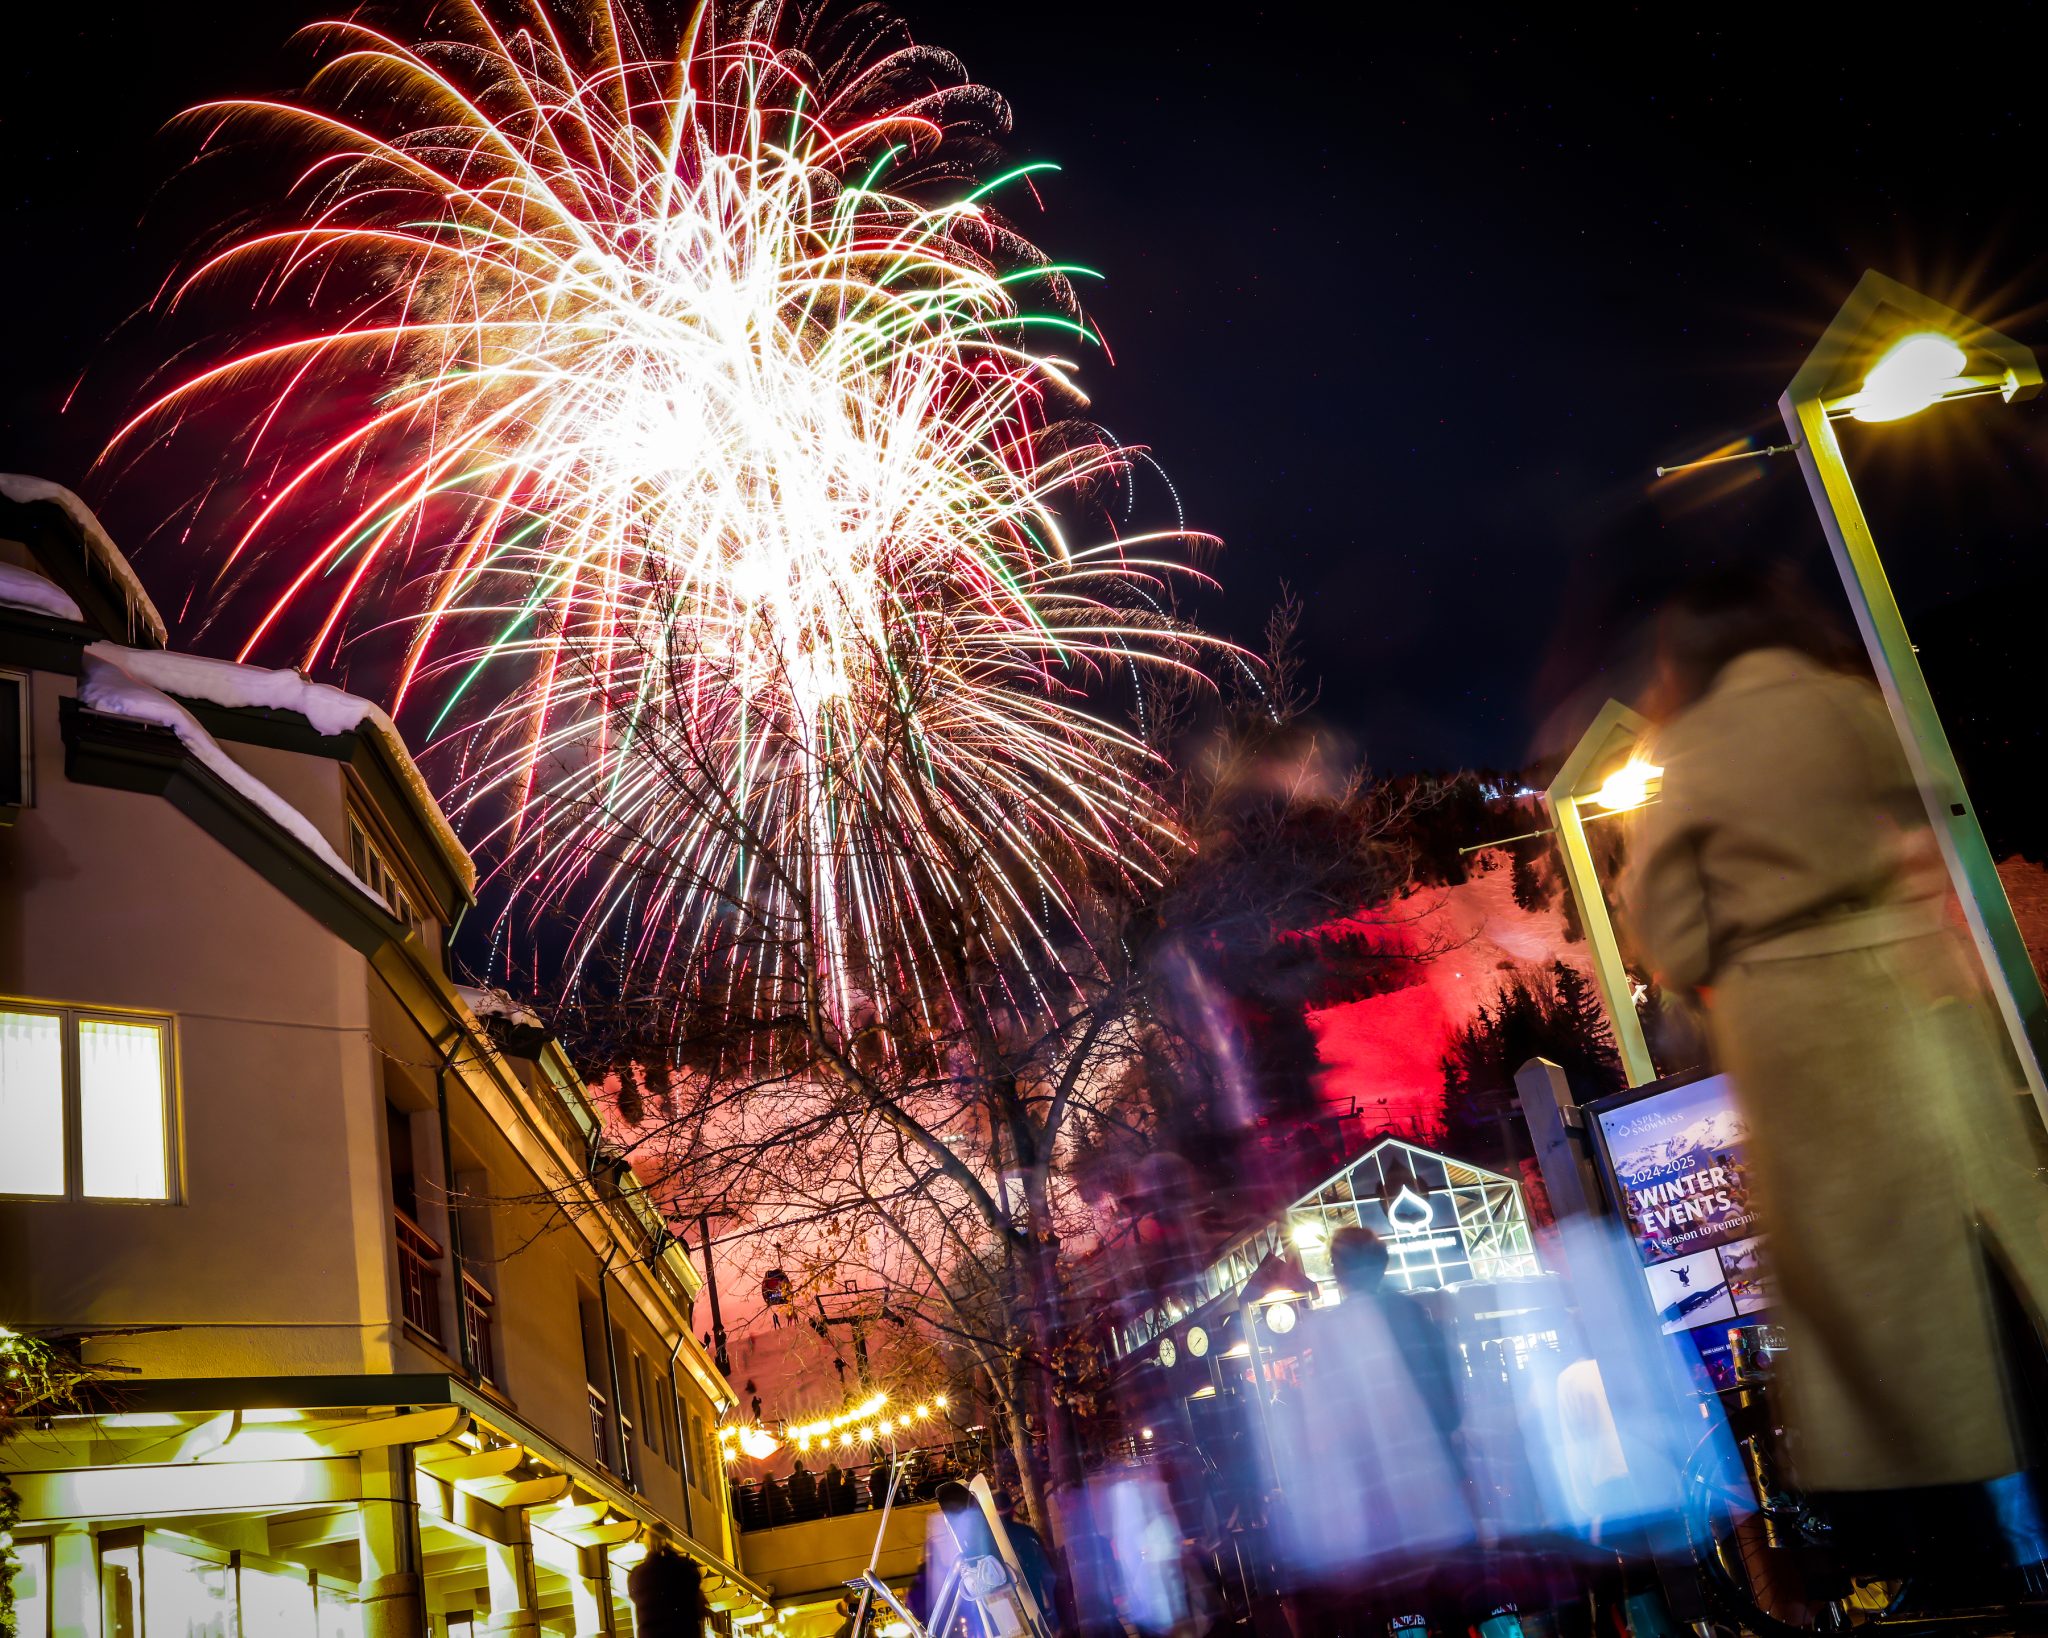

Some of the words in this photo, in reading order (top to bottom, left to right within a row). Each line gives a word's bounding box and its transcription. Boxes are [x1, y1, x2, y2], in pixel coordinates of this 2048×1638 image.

[1631, 1112, 1661, 1127] ASPEN
[1632, 1112, 1685, 1136] SNOWMASS
[1631, 1155, 1696, 1185] 2024-2025
[1635, 1166, 1728, 1209] WINTER
[1642, 1190, 1731, 1233] EVENTS
[1650, 1239, 1660, 1251] A
[1661, 1230, 1698, 1247] season
[1699, 1225, 1712, 1236] to
[1714, 1210, 1762, 1232] rememb
